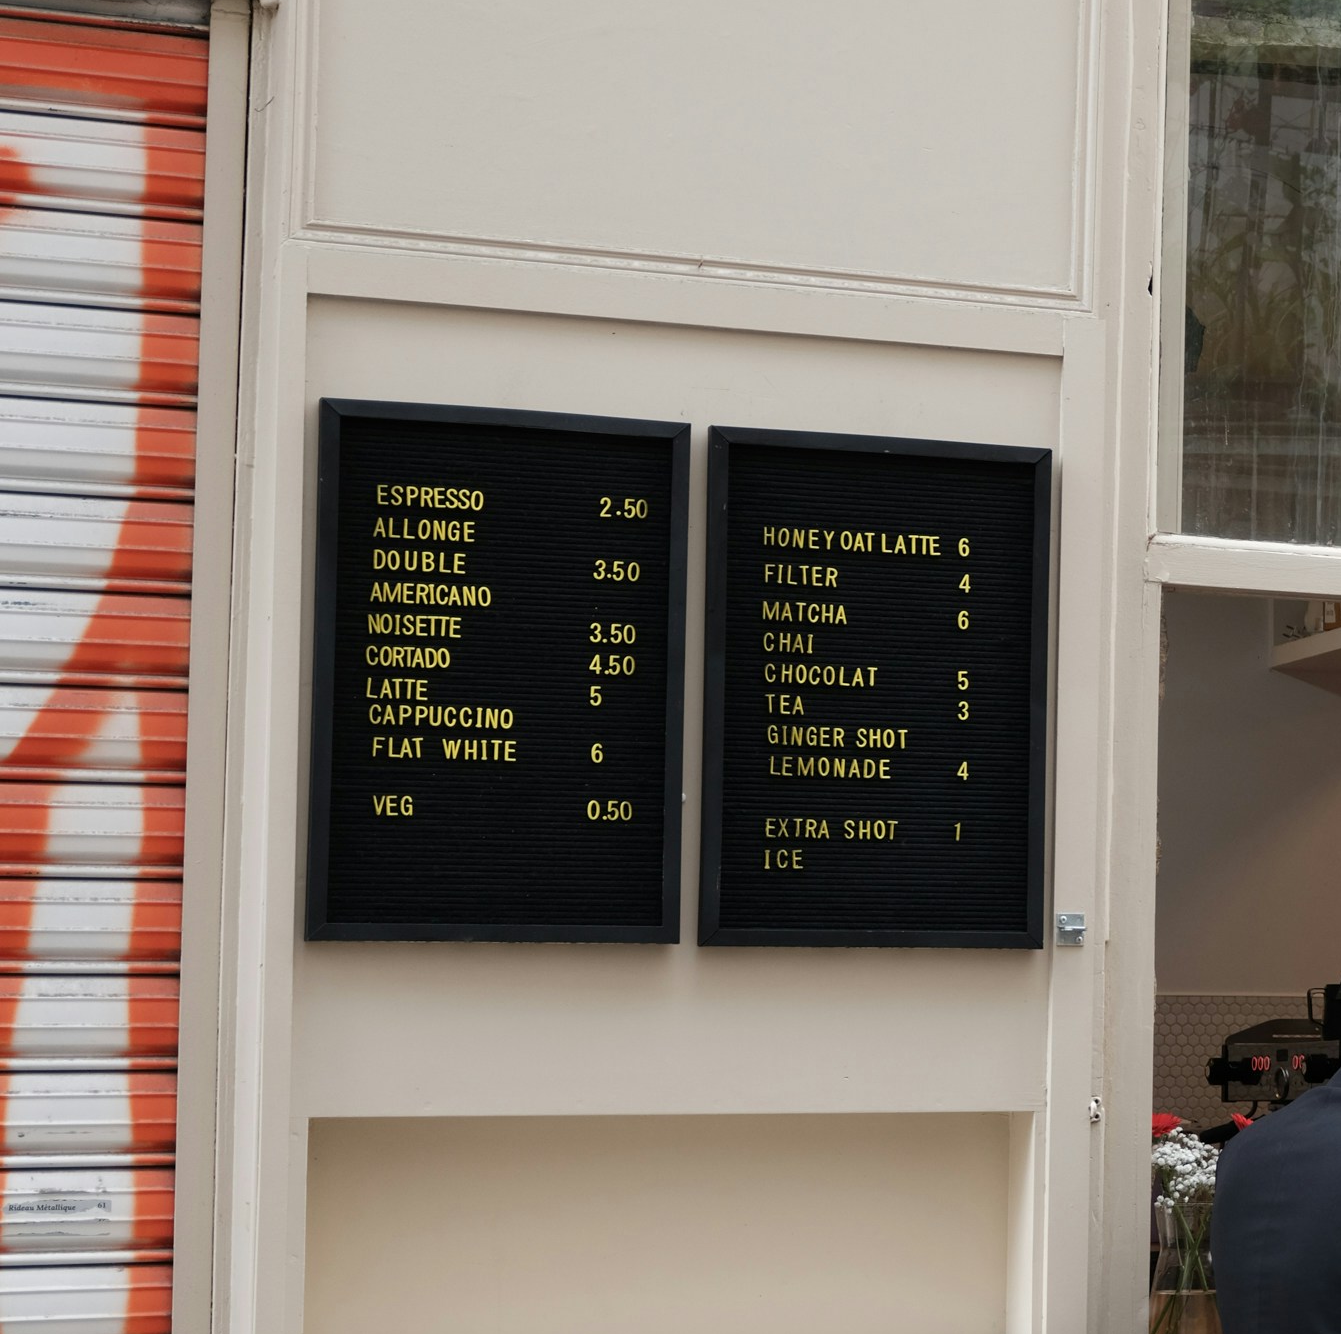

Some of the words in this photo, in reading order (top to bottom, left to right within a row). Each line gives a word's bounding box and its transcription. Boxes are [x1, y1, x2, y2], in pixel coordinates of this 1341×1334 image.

[377, 484, 484, 511] ESPRESSO
[600, 497, 648, 519] 2.50
[373, 517, 476, 543] ALLONGE
[763, 526, 834, 551] HONEY
[840, 531, 876, 553] OAT
[881, 533, 942, 556] LATTE
[958, 537, 970, 557] 6
[373, 548, 466, 575] DOUBLE
[593, 559, 641, 582] 3.50
[764, 563, 839, 588] FILTER
[959, 573, 972, 594] 4
[370, 582, 492, 607] AMERICANO
[368, 614, 462, 639] NOISETTE
[590, 623, 636, 645] 3.50
[762, 601, 848, 625] MATCHA
[958, 610, 970, 630] 6
[763, 632, 814, 654] CHAI
[366, 645, 451, 669] CORTADO
[589, 654, 636, 676] 4.50
[764, 663, 879, 688] CHOCOLAT
[958, 670, 970, 691] 5
[366, 677, 429, 701] LATTE
[590, 685, 603, 707] 5
[369, 704, 515, 730] CAPPUCCINO
[766, 693, 805, 716] TEA
[958, 700, 970, 721] 3
[372, 736, 424, 759] FLAT
[442, 738, 518, 762] WHITE
[591, 742, 604, 764] 6
[767, 724, 845, 748] GINGER
[856, 728, 909, 750] SHOT
[769, 755, 892, 780] LEMONADE
[957, 761, 969, 781] 4
[372, 794, 414, 817] VEG
[587, 799, 634, 822] 0.50
[765, 817, 831, 840] EXTRA
[843, 819, 899, 841] SHOT
[954, 822, 962, 842] 1
[764, 849, 804, 870] ICE
[8, 1204, 34, 1212] Rideau
[36, 1203, 76, 1213] Métallique
